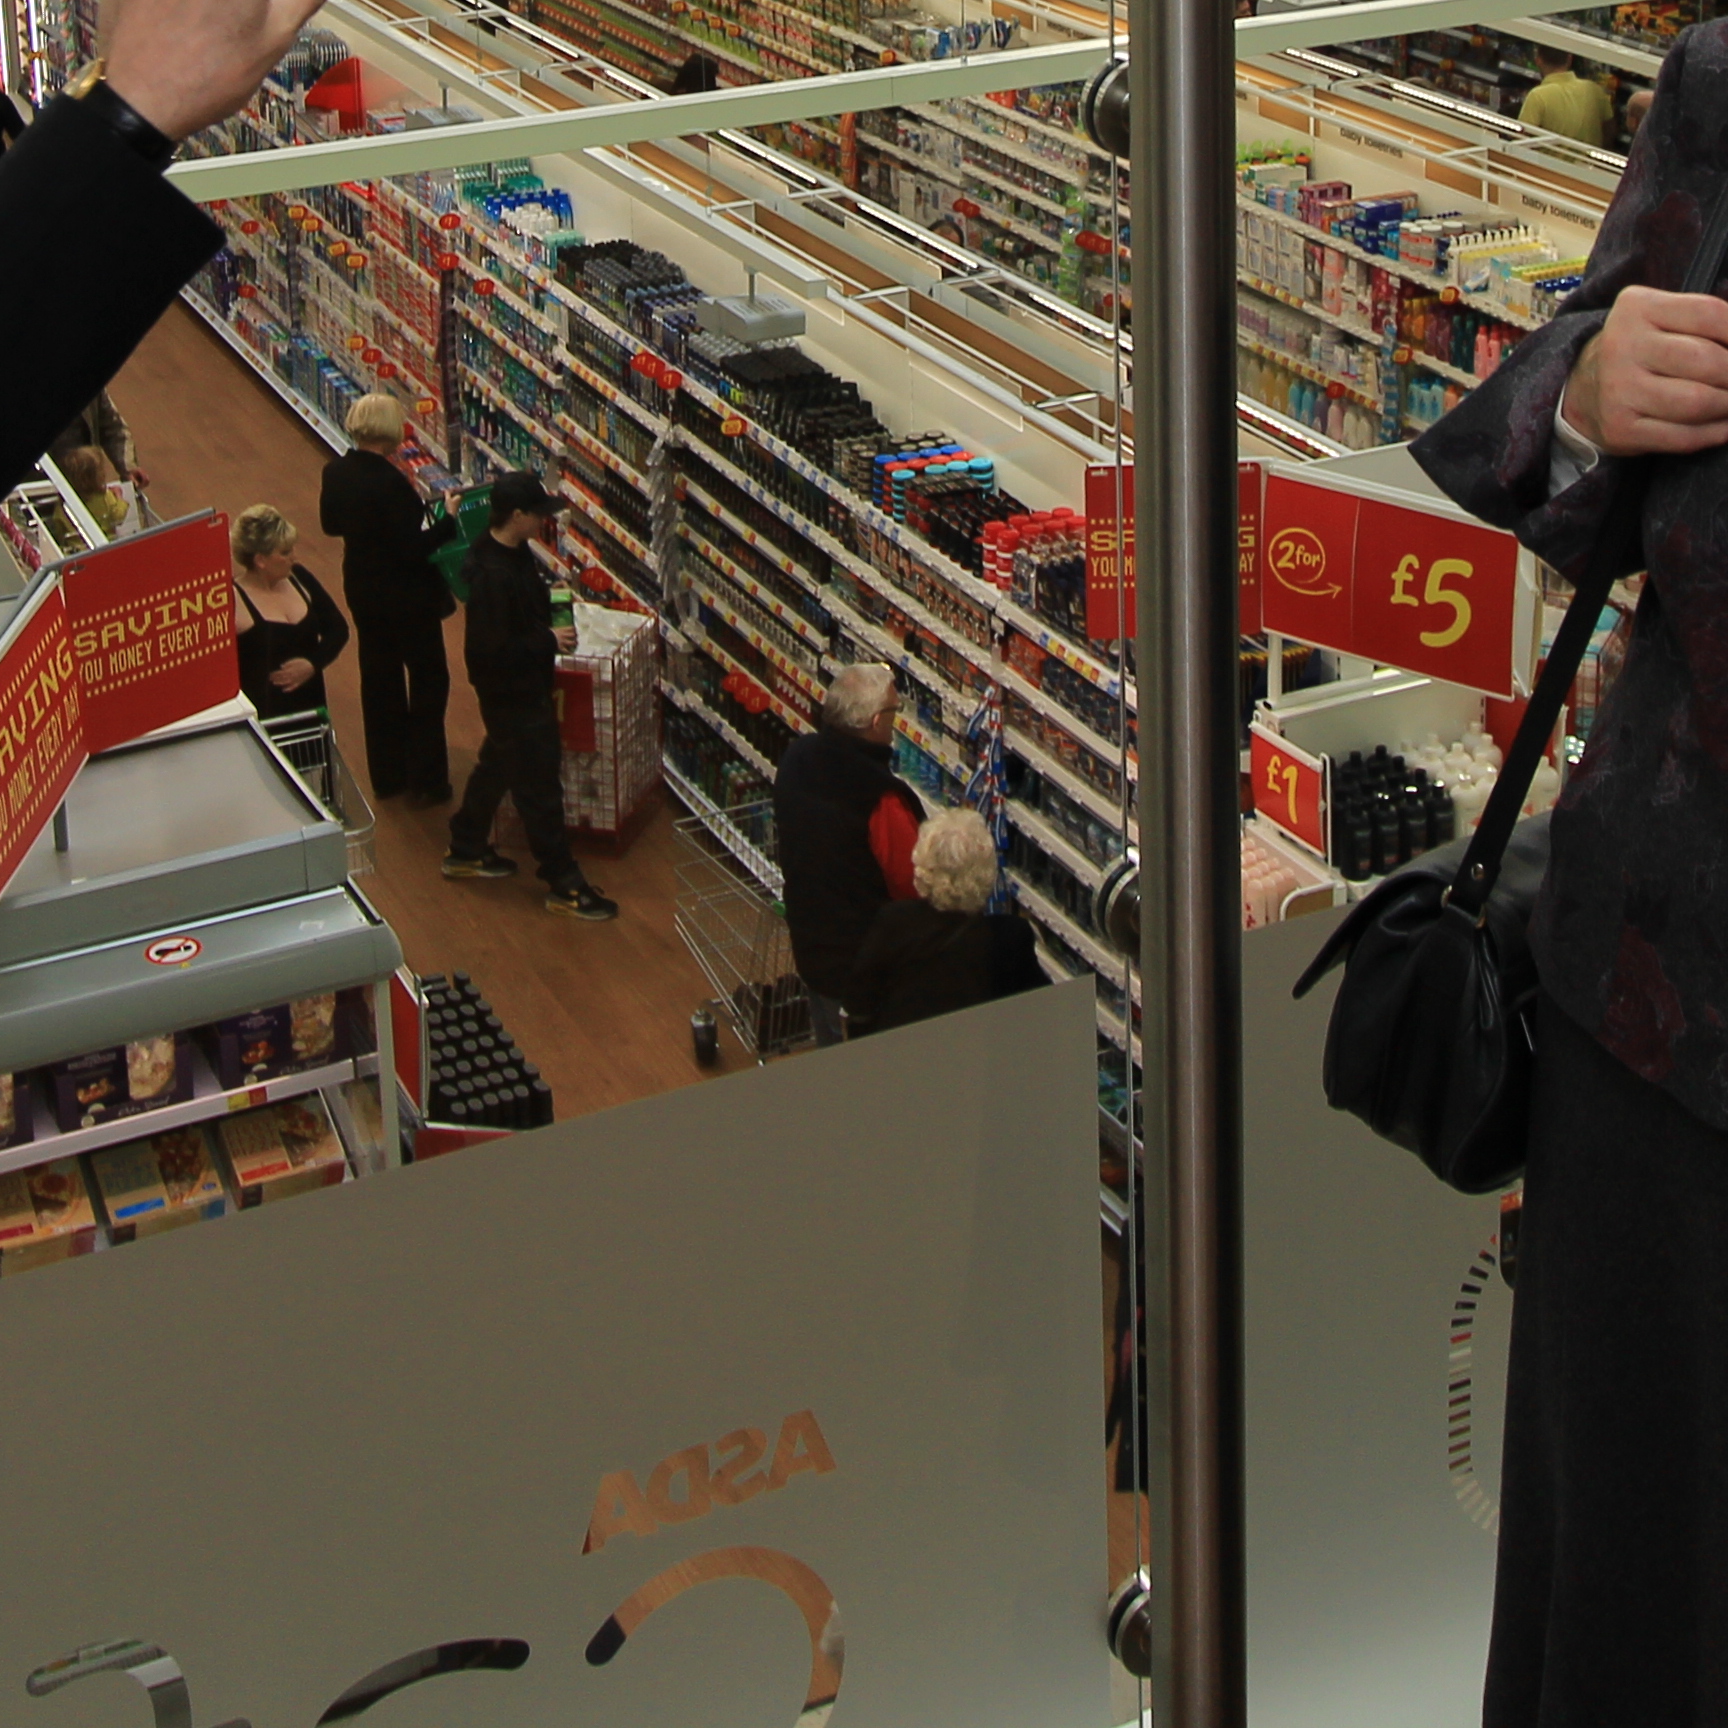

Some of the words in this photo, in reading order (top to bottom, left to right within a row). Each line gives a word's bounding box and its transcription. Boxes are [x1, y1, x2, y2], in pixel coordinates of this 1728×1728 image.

[1522, 195, 1546, 215] baby
[73, 582, 229, 658] SAVING
[1389, 553, 1475, 649] £5
[109, 639, 153, 676] MONEY
[159, 622, 200, 658] EVERY
[207, 610, 230, 640] DAY
[7, 747, 37, 819] MONEY
[36, 705, 65, 774] EVERY
[63, 681, 81, 732] DAY
[1266, 753, 1301, 826] £1
